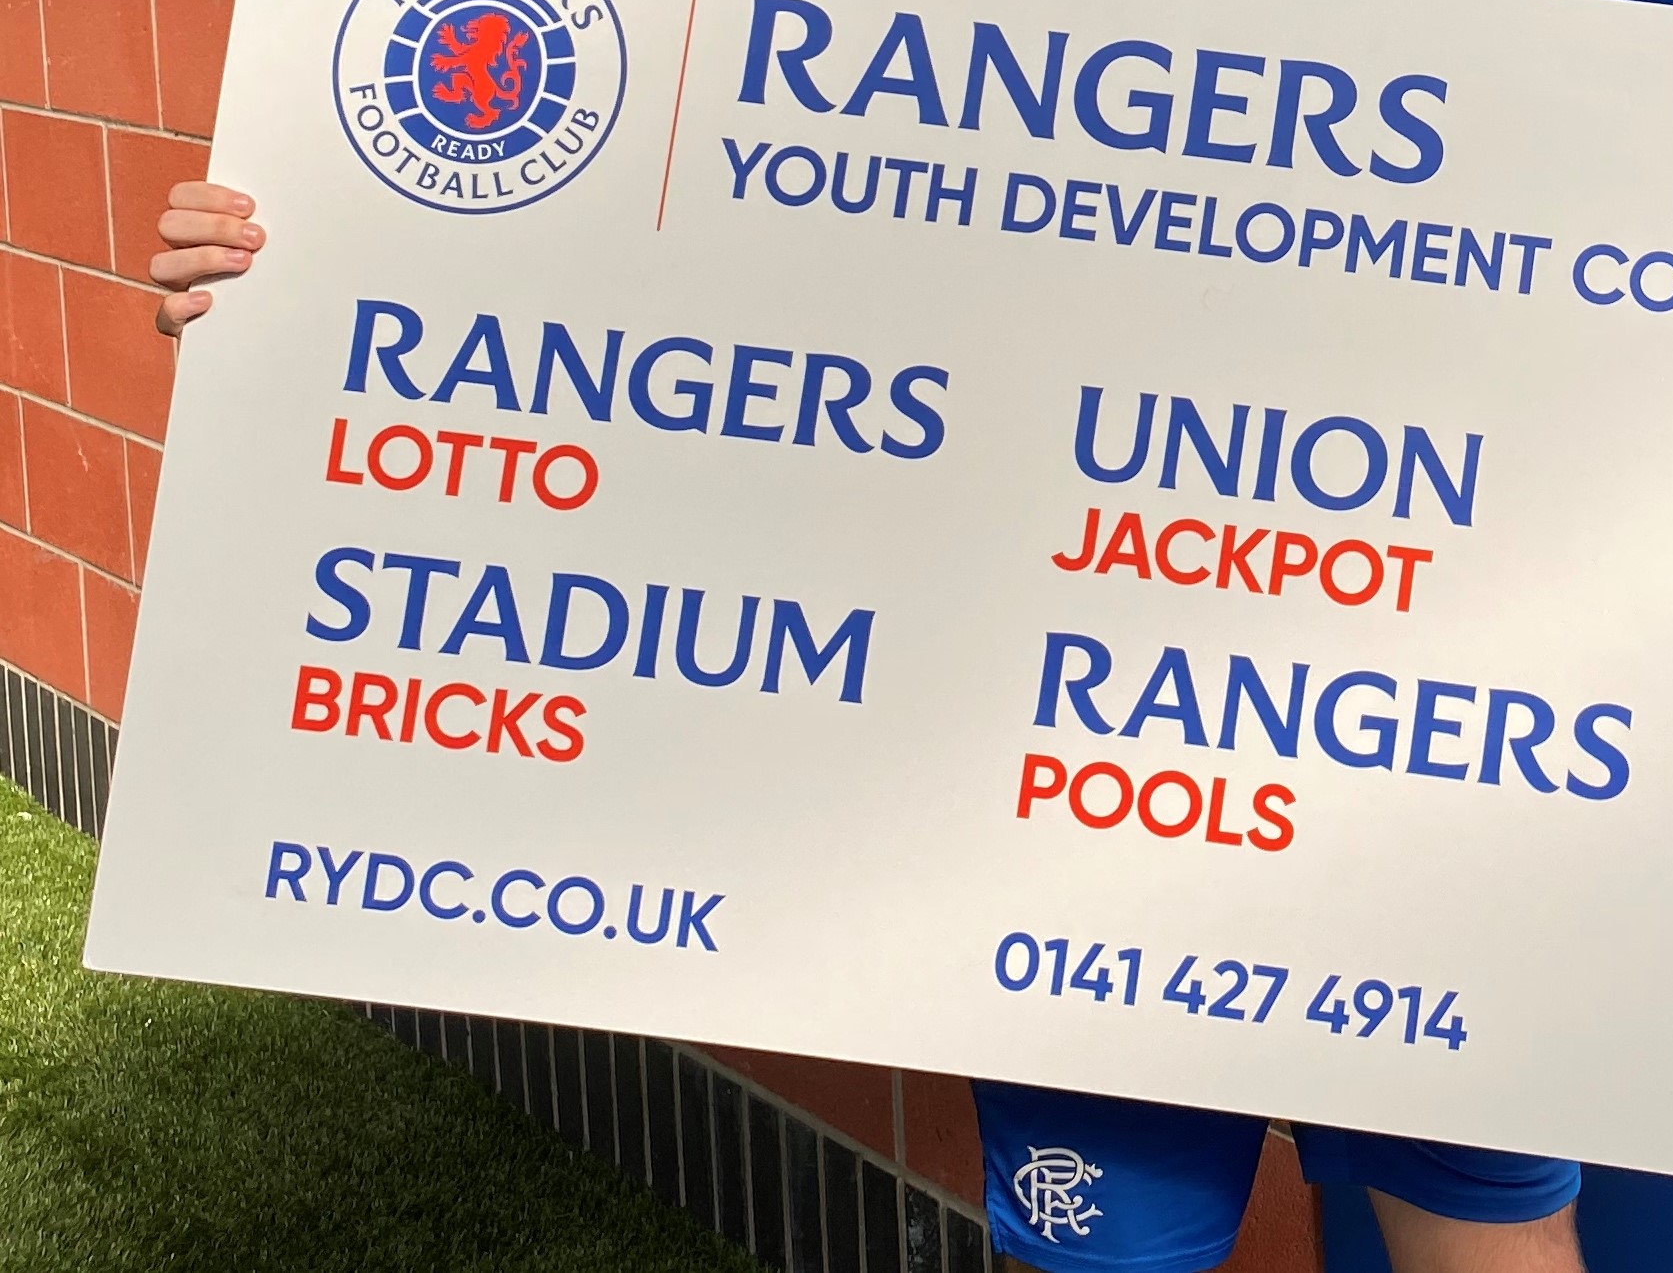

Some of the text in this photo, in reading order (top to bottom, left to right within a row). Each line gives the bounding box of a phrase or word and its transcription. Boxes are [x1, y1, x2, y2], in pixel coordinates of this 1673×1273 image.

[349, 82, 600, 199] FOOTBALL CLUB
[430, 133, 507, 161] READY
[724, 139, 977, 225] YOUTH
[1001, 173, 1552, 295] DEVELOPMENT
[343, 299, 949, 461] RANGERS
[325, 417, 601, 512] LOTTO
[1074, 386, 1483, 527] UNION
[1050, 507, 1434, 614] JACKPOT
[305, 546, 876, 704] STADIUM
[290, 664, 588, 764] BRICKS
[1032, 632, 1634, 802] RANGERS
[1015, 752, 1298, 853] POOLS
[264, 840, 726, 953] RYDC.CO.UK
[993, 931, 1469, 1052] 0141 427 4914
